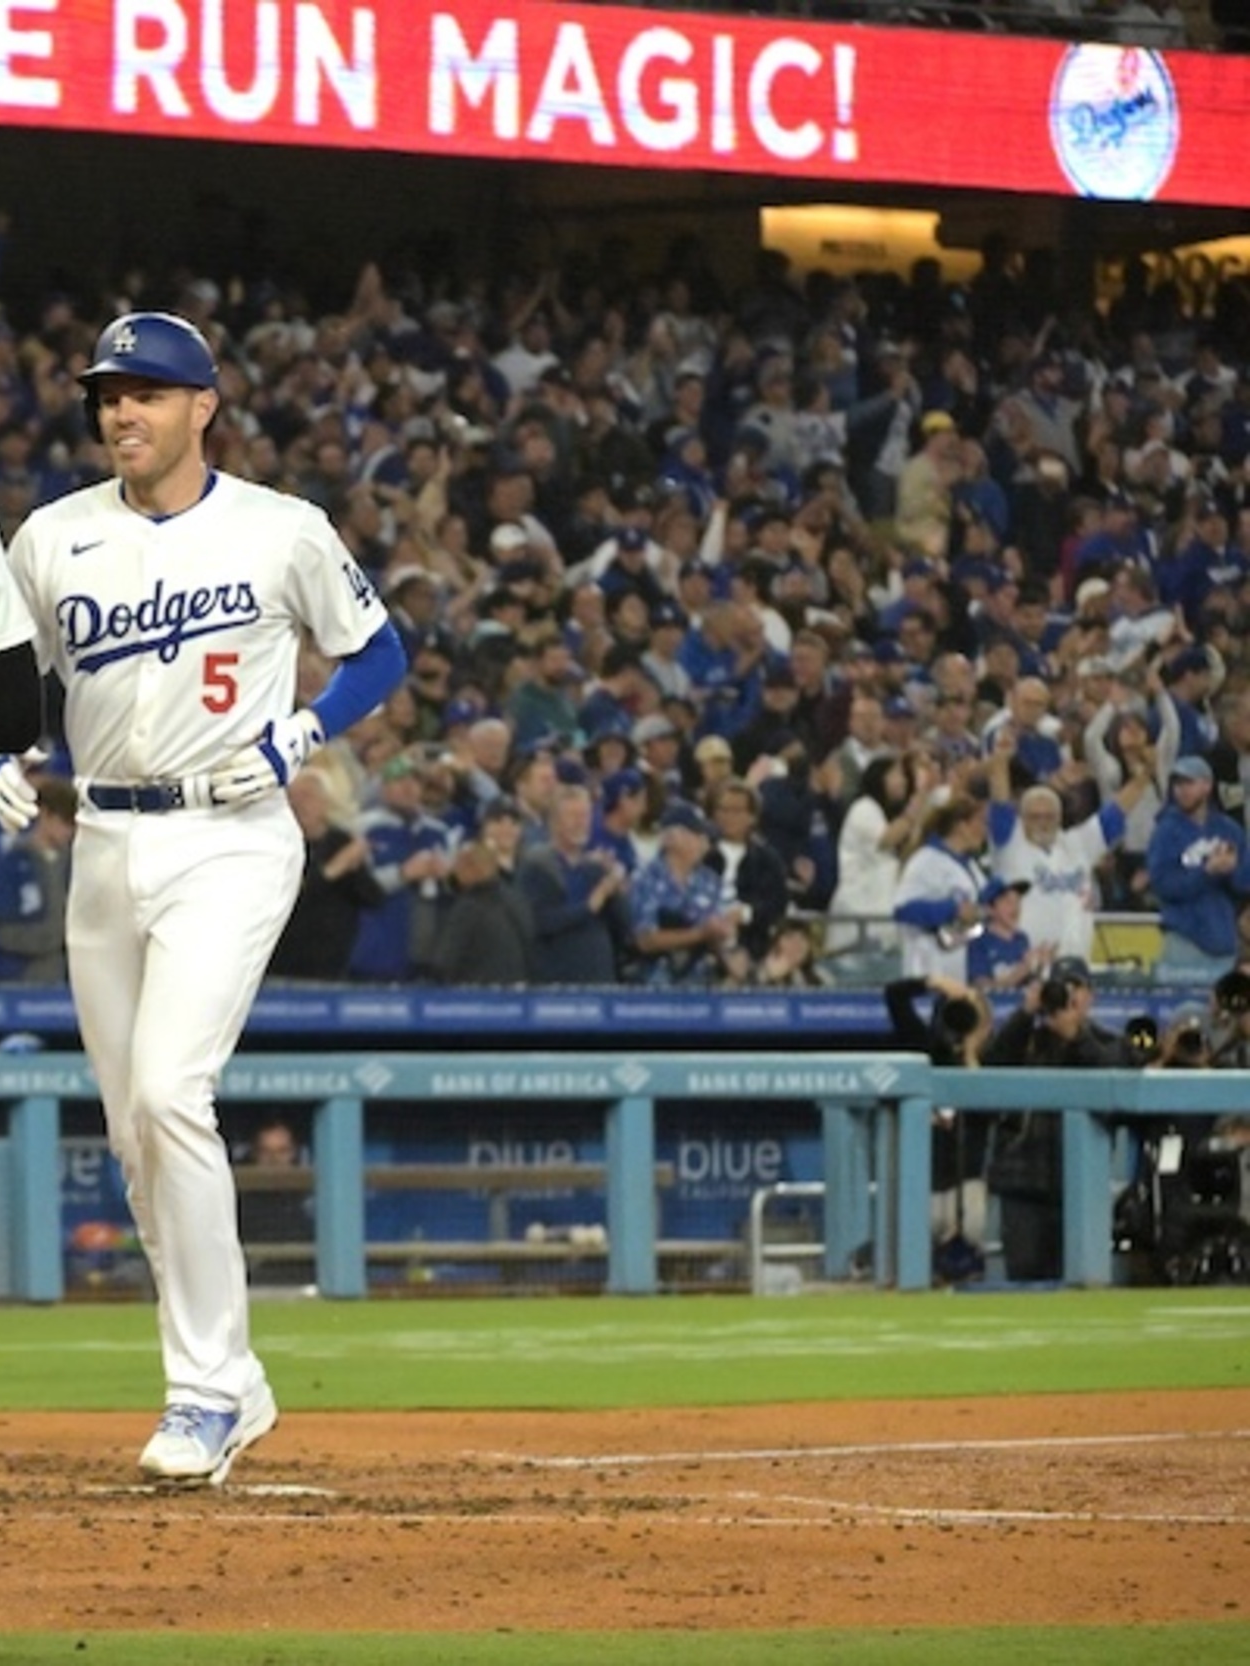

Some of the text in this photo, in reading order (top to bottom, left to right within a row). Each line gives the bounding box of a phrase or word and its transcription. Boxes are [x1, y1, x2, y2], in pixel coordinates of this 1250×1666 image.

[111, 0, 377, 130] RUN
[427, 12, 859, 162] MAGIC!
[113, 322, 138, 353] LA
[56, 579, 263, 673] Dodgers
[201, 652, 239, 714] 5
[257, 1072, 351, 1095] AMERICA
[432, 1073, 610, 1095] BANK OF AMERICA
[688, 1072, 860, 1093] BANK OF AMERICA
